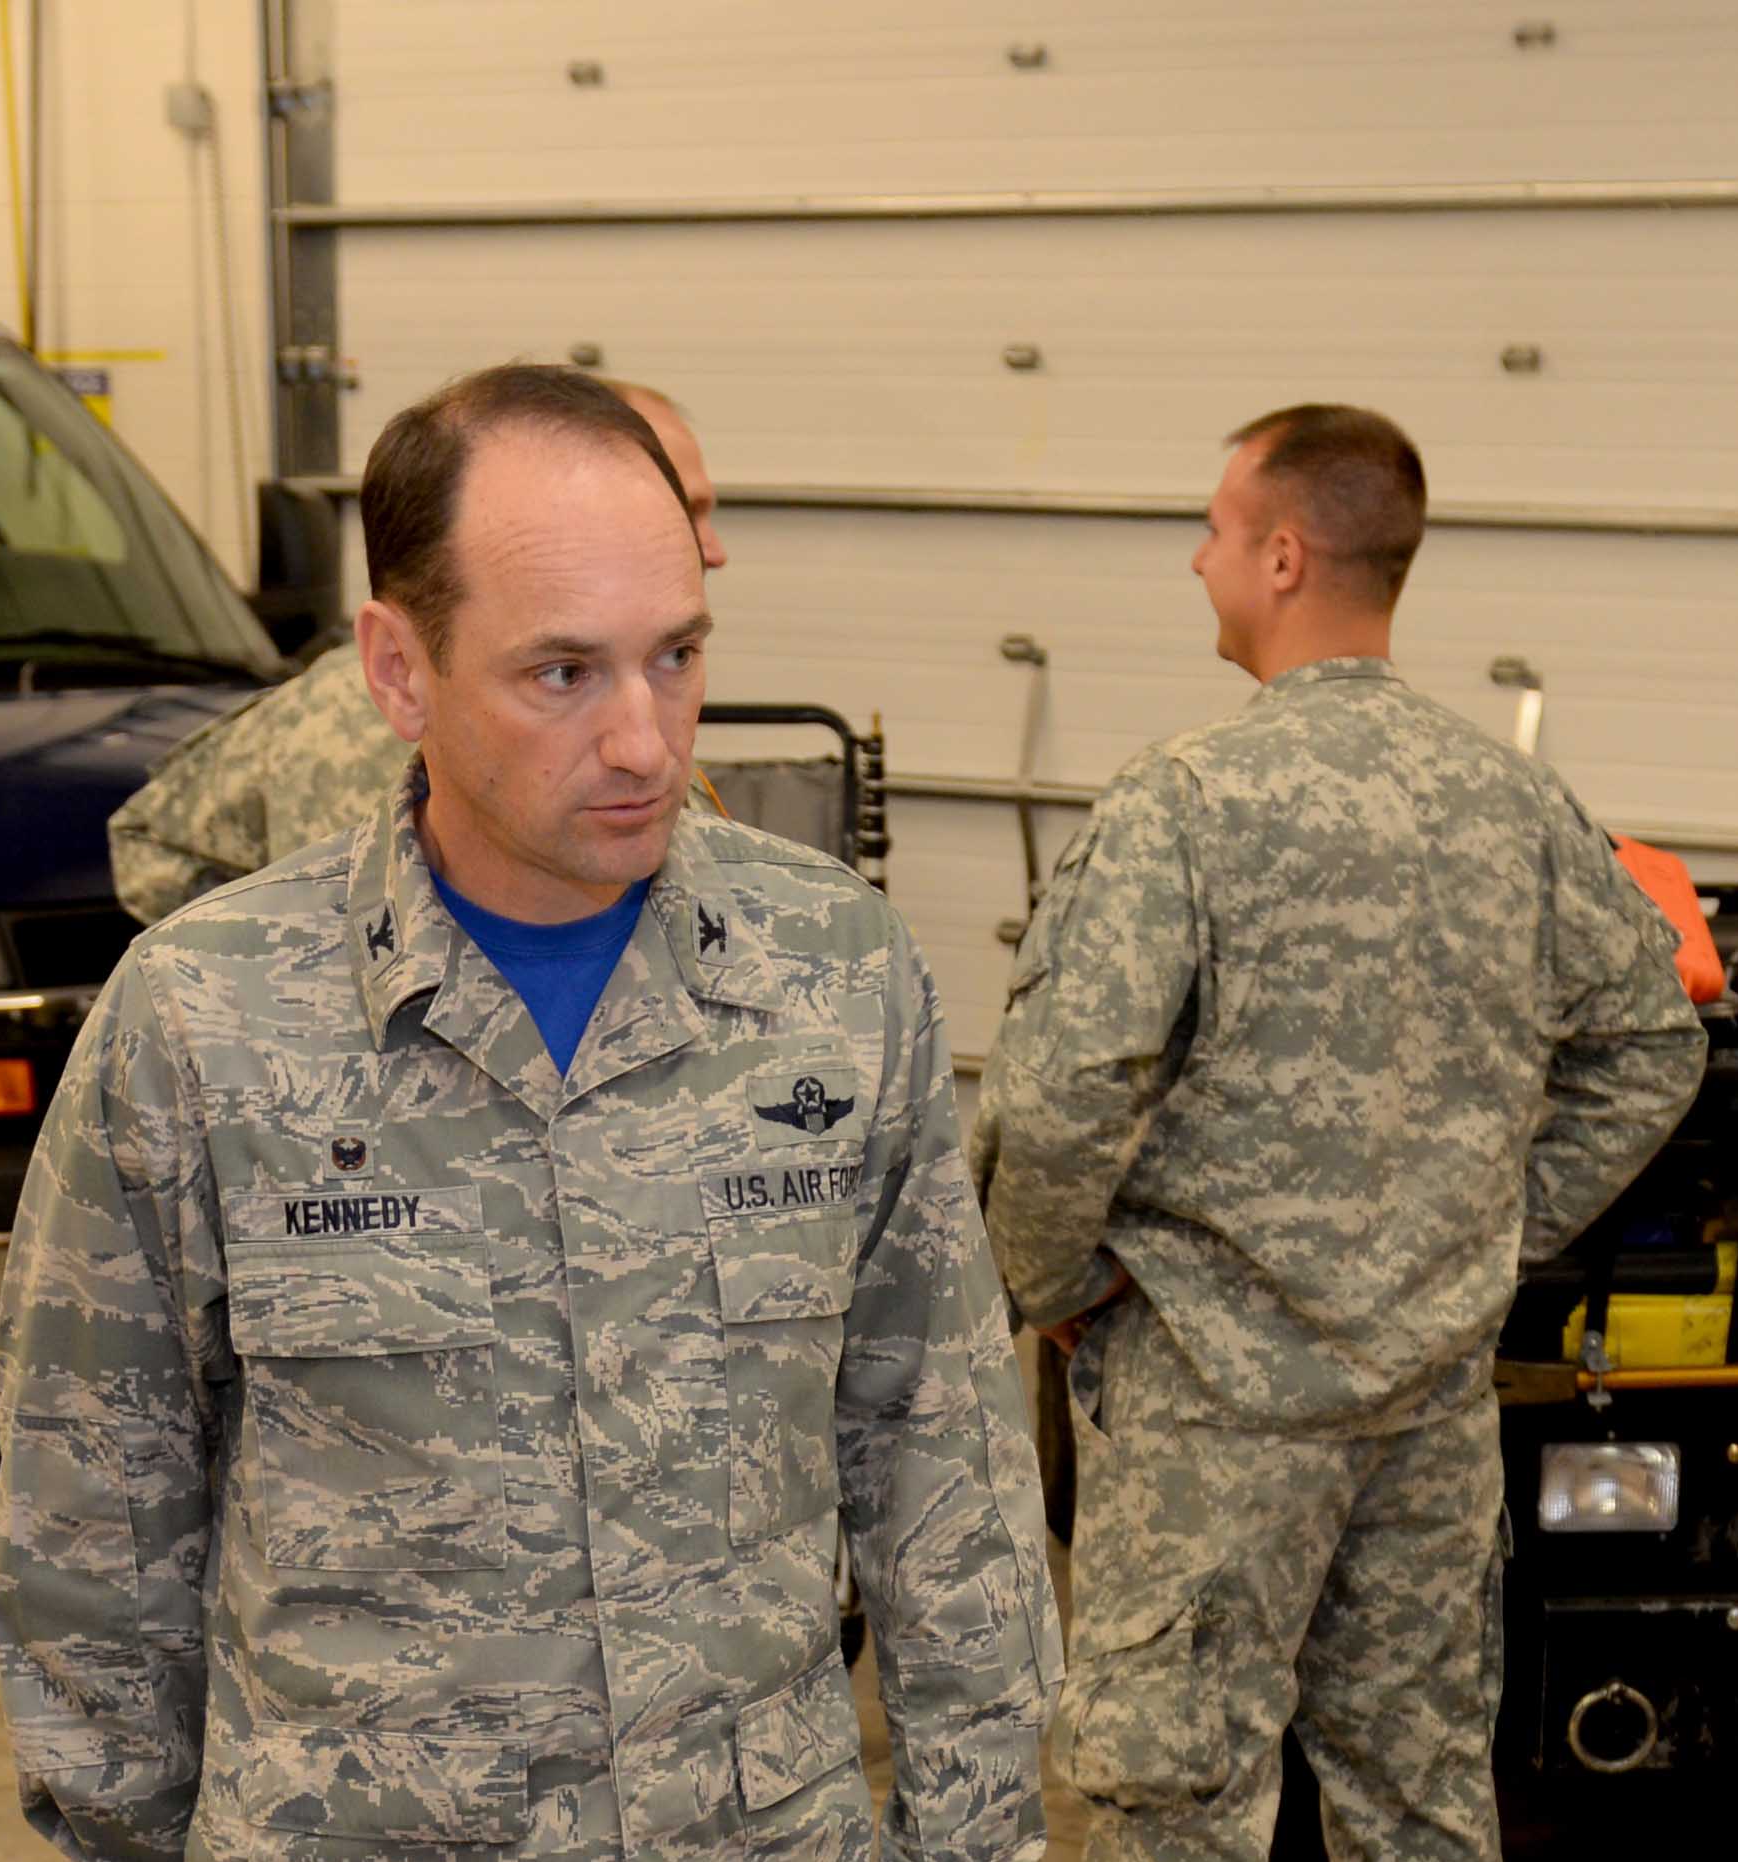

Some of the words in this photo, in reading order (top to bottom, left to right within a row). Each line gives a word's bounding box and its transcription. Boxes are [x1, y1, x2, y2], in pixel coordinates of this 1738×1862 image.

[724, 1176, 775, 1210] U.S.
[782, 1169, 824, 1205] AIR
[284, 1195, 421, 1235] KENNEDY
